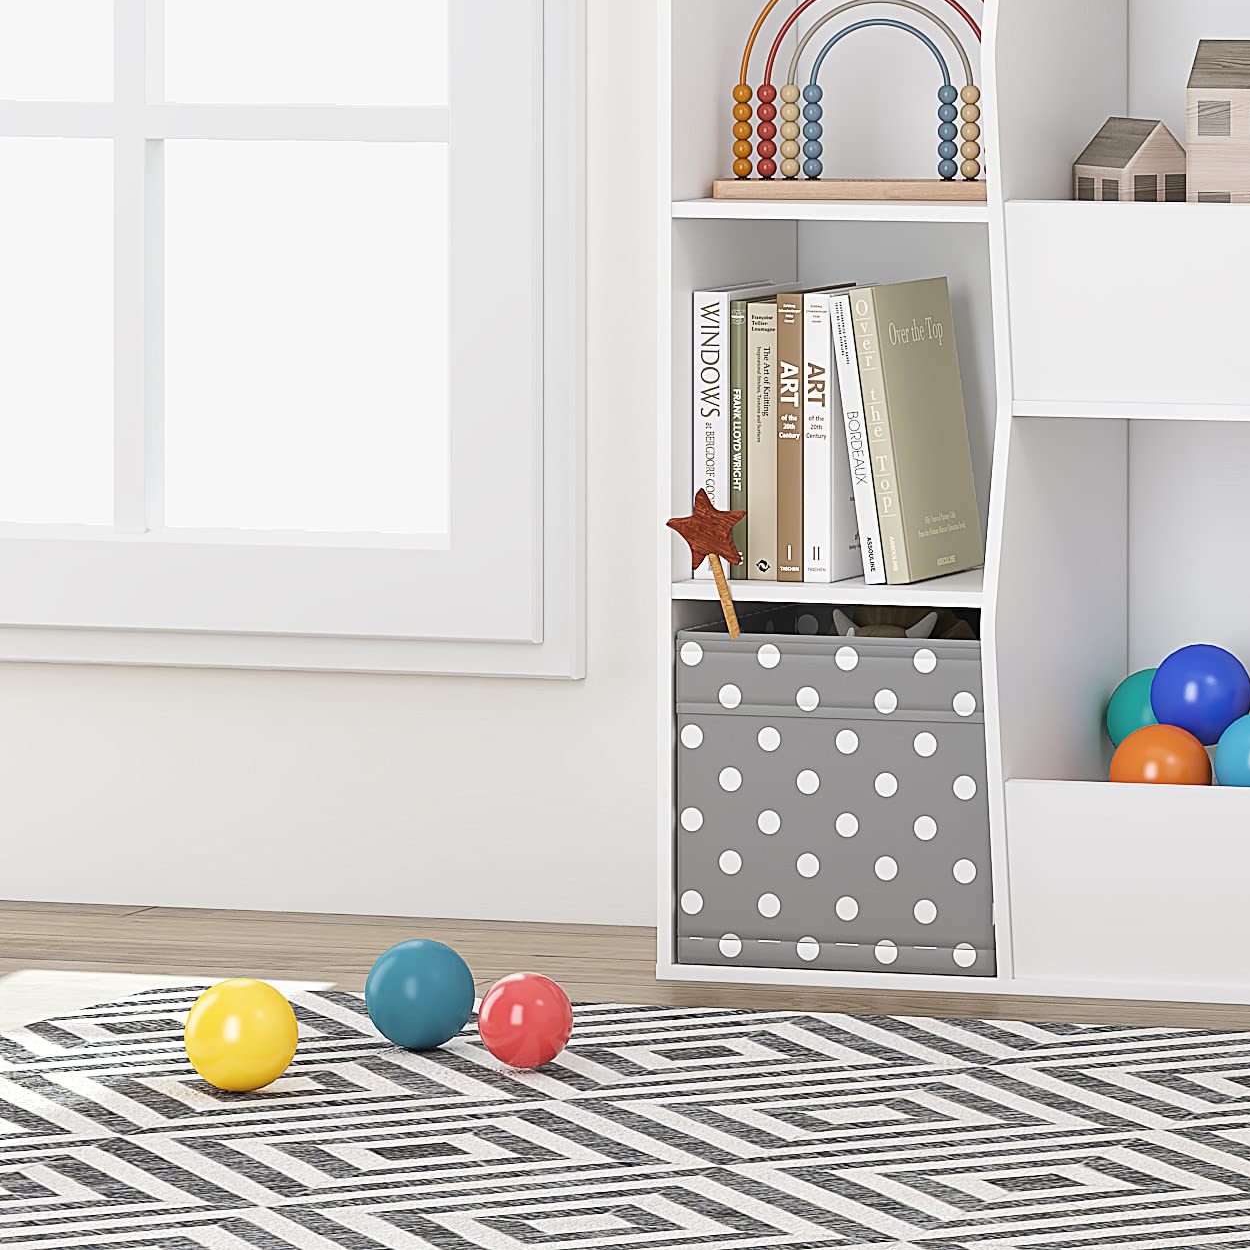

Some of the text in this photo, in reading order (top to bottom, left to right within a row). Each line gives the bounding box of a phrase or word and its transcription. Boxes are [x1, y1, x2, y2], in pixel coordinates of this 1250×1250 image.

[888, 316, 944, 346] Over the Top
[700, 302, 720, 417] WINDOWS
[762, 346, 771, 417] The Art of Knitting
[780, 360, 799, 408] ART
[807, 362, 825, 407] ART
[705, 431, 715, 477] BERGDORF
[732, 388, 742, 491] FRANK LLOYD WRIGHT
[778, 431, 800, 440] Century
[806, 432, 826, 440] Century
[846, 411, 868, 485] BORDEAUX
